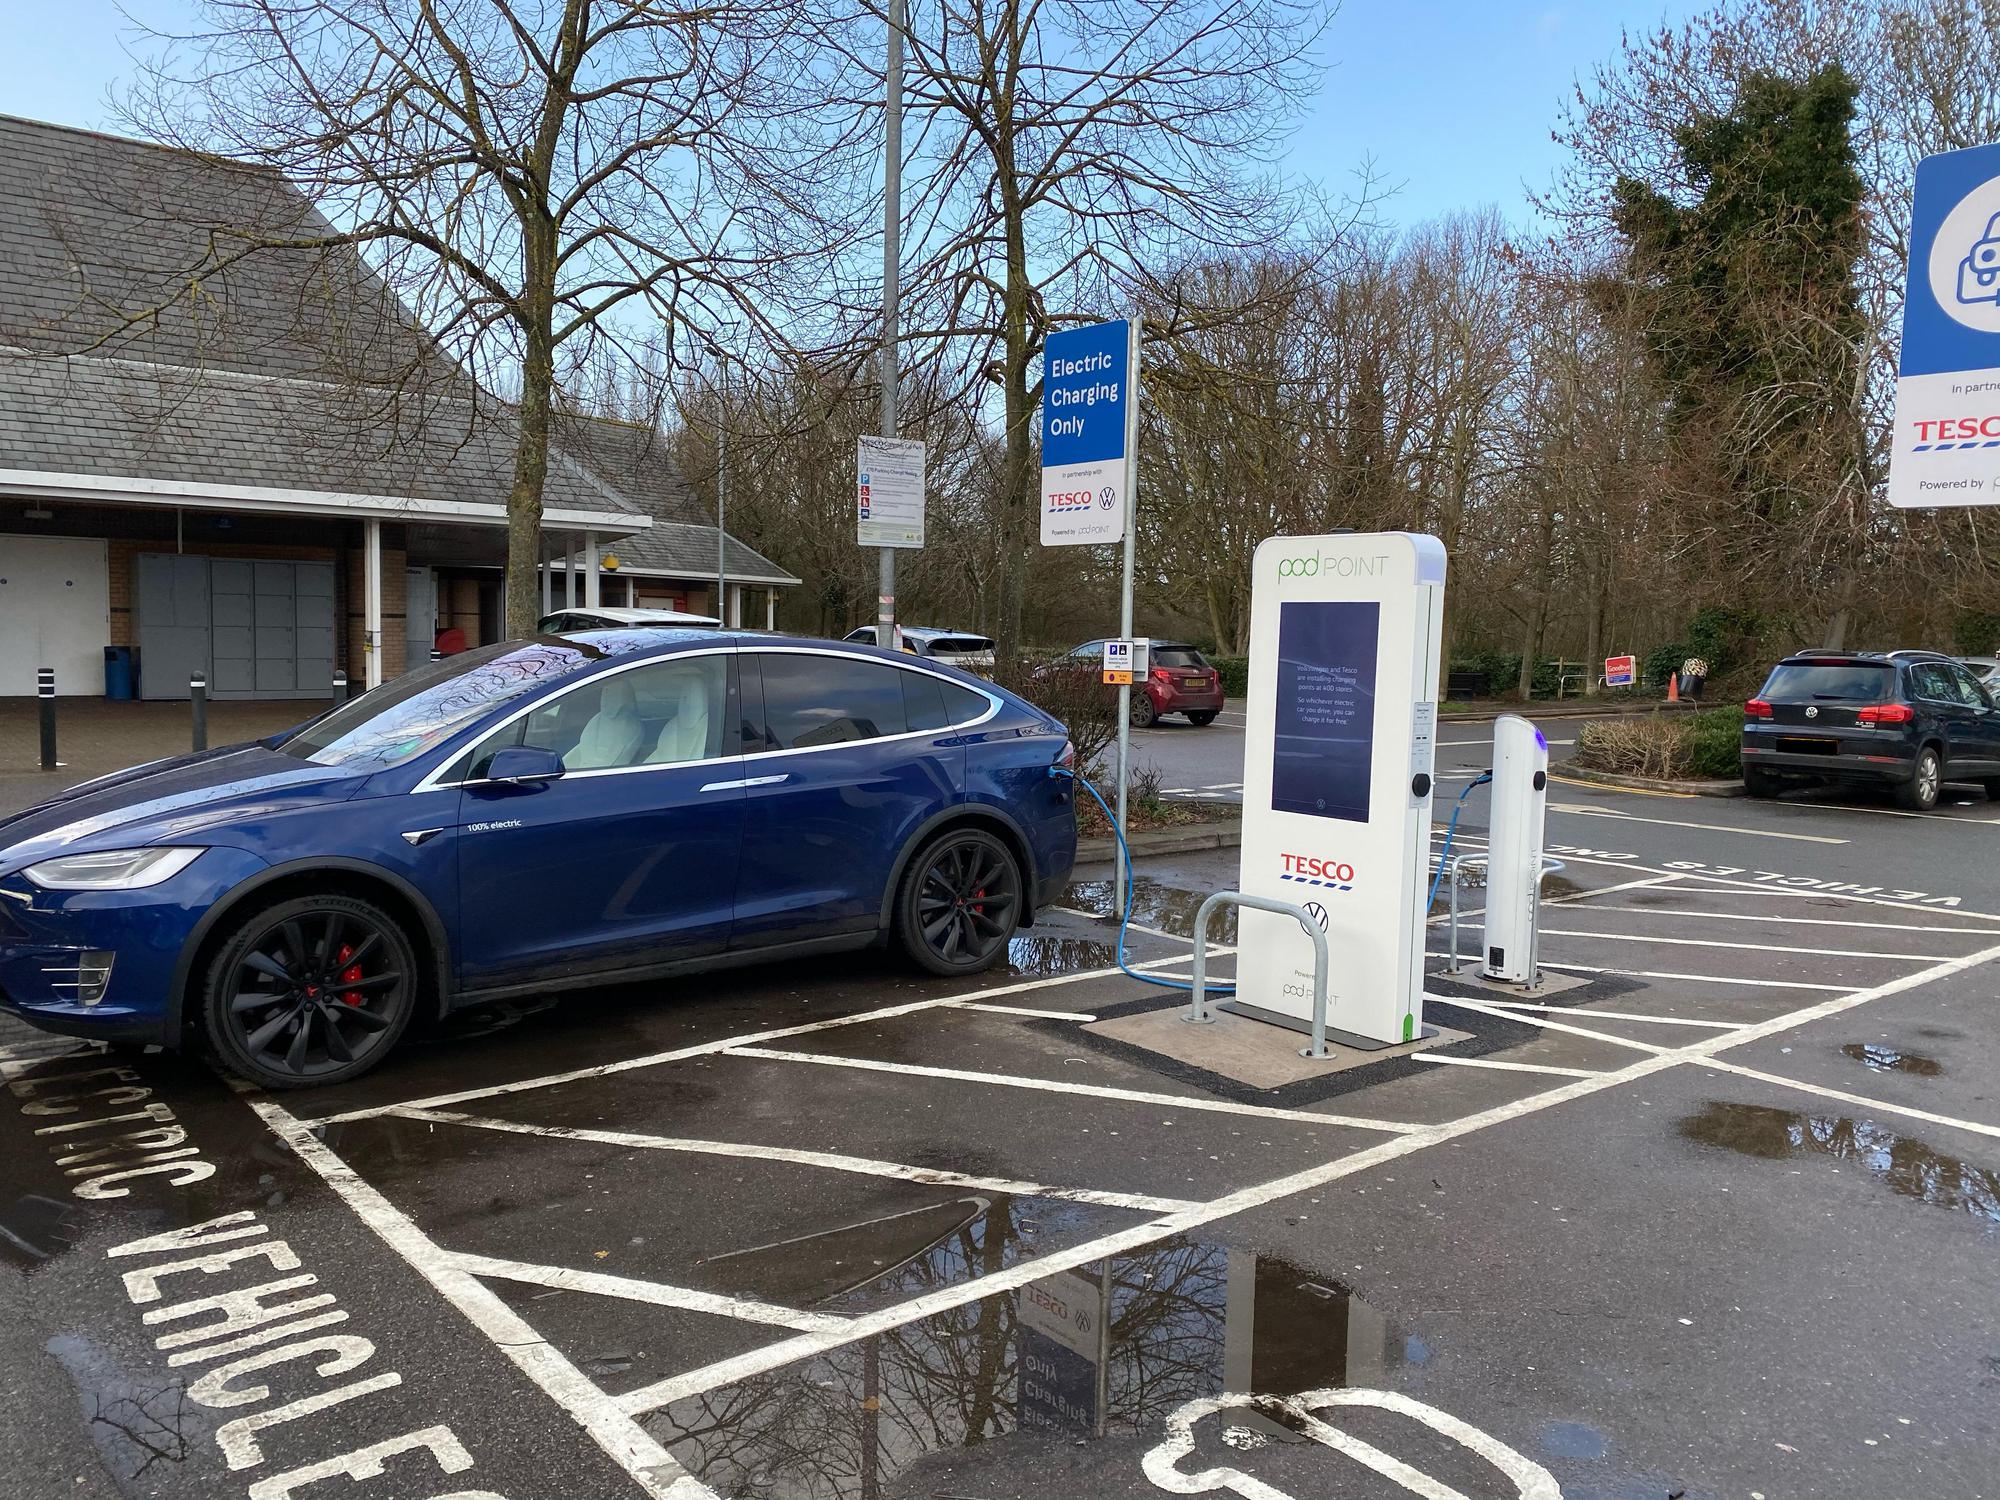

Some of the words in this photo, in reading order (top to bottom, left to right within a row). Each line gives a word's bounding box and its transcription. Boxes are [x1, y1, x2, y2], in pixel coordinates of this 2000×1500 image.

[1052, 352, 1112, 378] Electric
[1051, 382, 1119, 407] Charging
[1952, 384, 1962, 394] In
[1050, 416, 1085, 437] Only
[1067, 470, 1092, 479] partnership
[1919, 479, 1968, 490] Powered
[1971, 479, 1984, 490] by
[1049, 491, 1092, 506] TESCO
[1091, 525, 1110, 533] POINT
[1278, 549, 1319, 585] pod
[1323, 556, 1389, 577] POINT
[1342, 666, 1358, 674] Tesco
[1306, 675, 1332, 683] installing
[1306, 697, 1333, 705] whichever
[1301, 715, 1320, 724] charge
[467, 822, 489, 832] 100%
[490, 819, 522, 830] electric
[1280, 853, 1355, 882] TESCO
[1661, 860, 1962, 907] VEHICLES
[1282, 983, 1304, 998] pod
